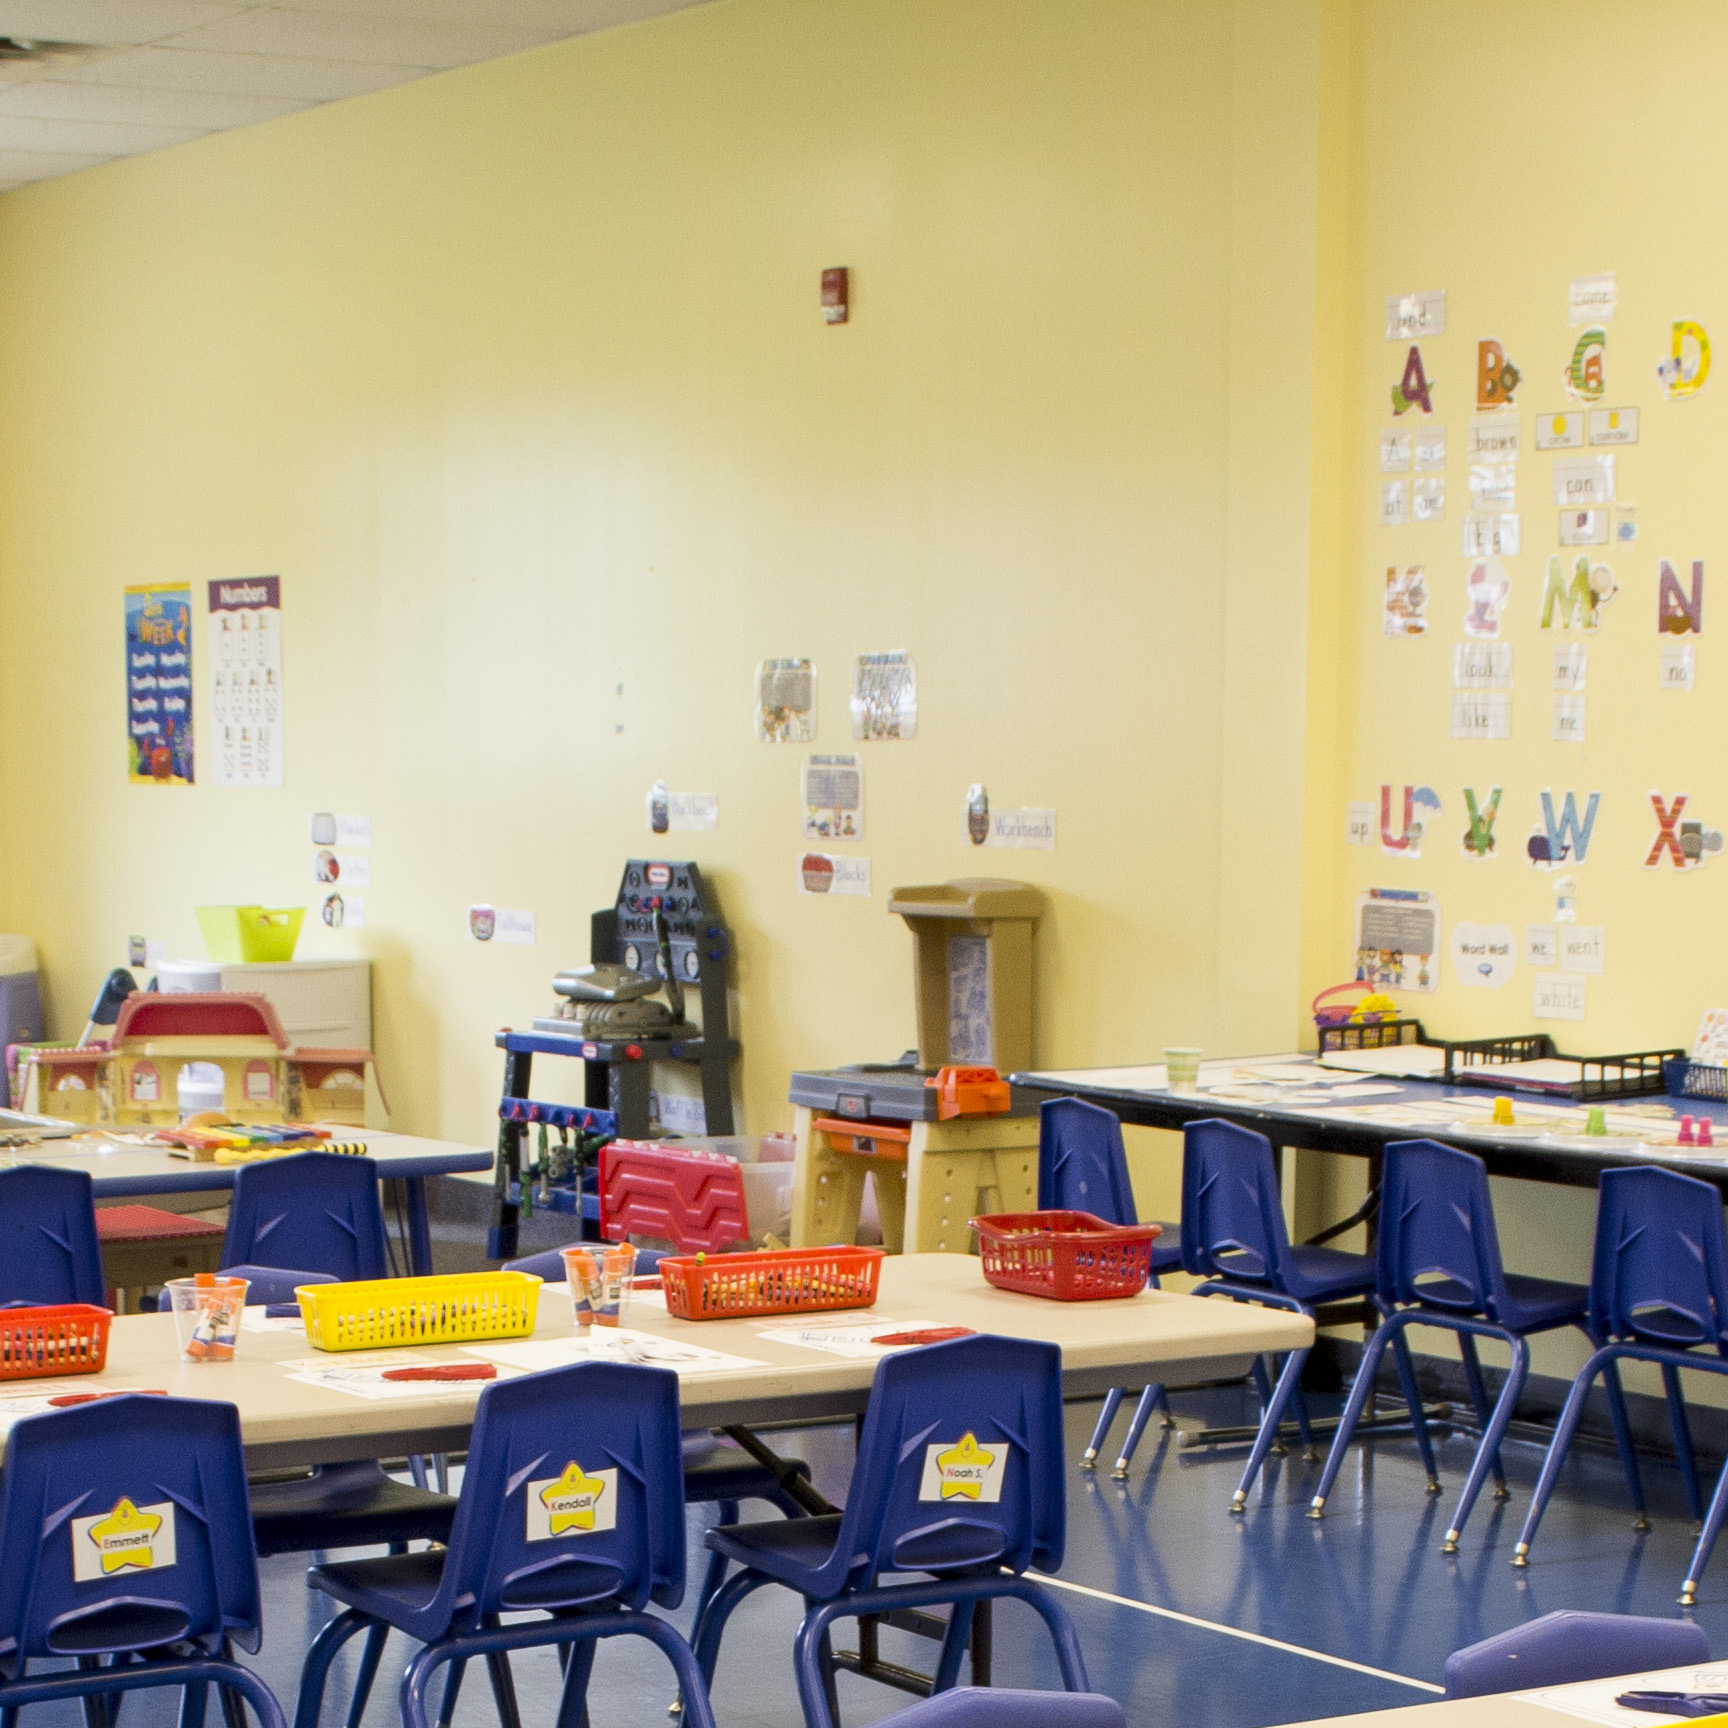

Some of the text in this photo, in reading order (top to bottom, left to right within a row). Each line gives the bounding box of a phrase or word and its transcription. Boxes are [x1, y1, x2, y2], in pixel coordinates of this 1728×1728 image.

[1670, 321, 1712, 397] D
[1392, 345, 1433, 416] A
[1475, 341, 1505, 411] B
[1475, 427, 1518, 453] brown
[1540, 556, 1593, 630] M
[1658, 560, 1705, 634] N
[1667, 666, 1688, 682] no
[1380, 784, 1414, 850] U
[1462, 787, 1504, 857] V
[1540, 791, 1602, 862] W
[1351, 820, 1368, 843] up
[1644, 794, 1689, 868] X
[1460, 943, 1510, 956] Word Wall
[1530, 943, 1548, 957] we
[1566, 932, 1602, 957] went
[1539, 981, 1582, 1008] white
[946, 1467, 983, 1479] Noah S.
[550, 1496, 592, 1512] Kendall
[103, 1533, 149, 1550] Emmett
